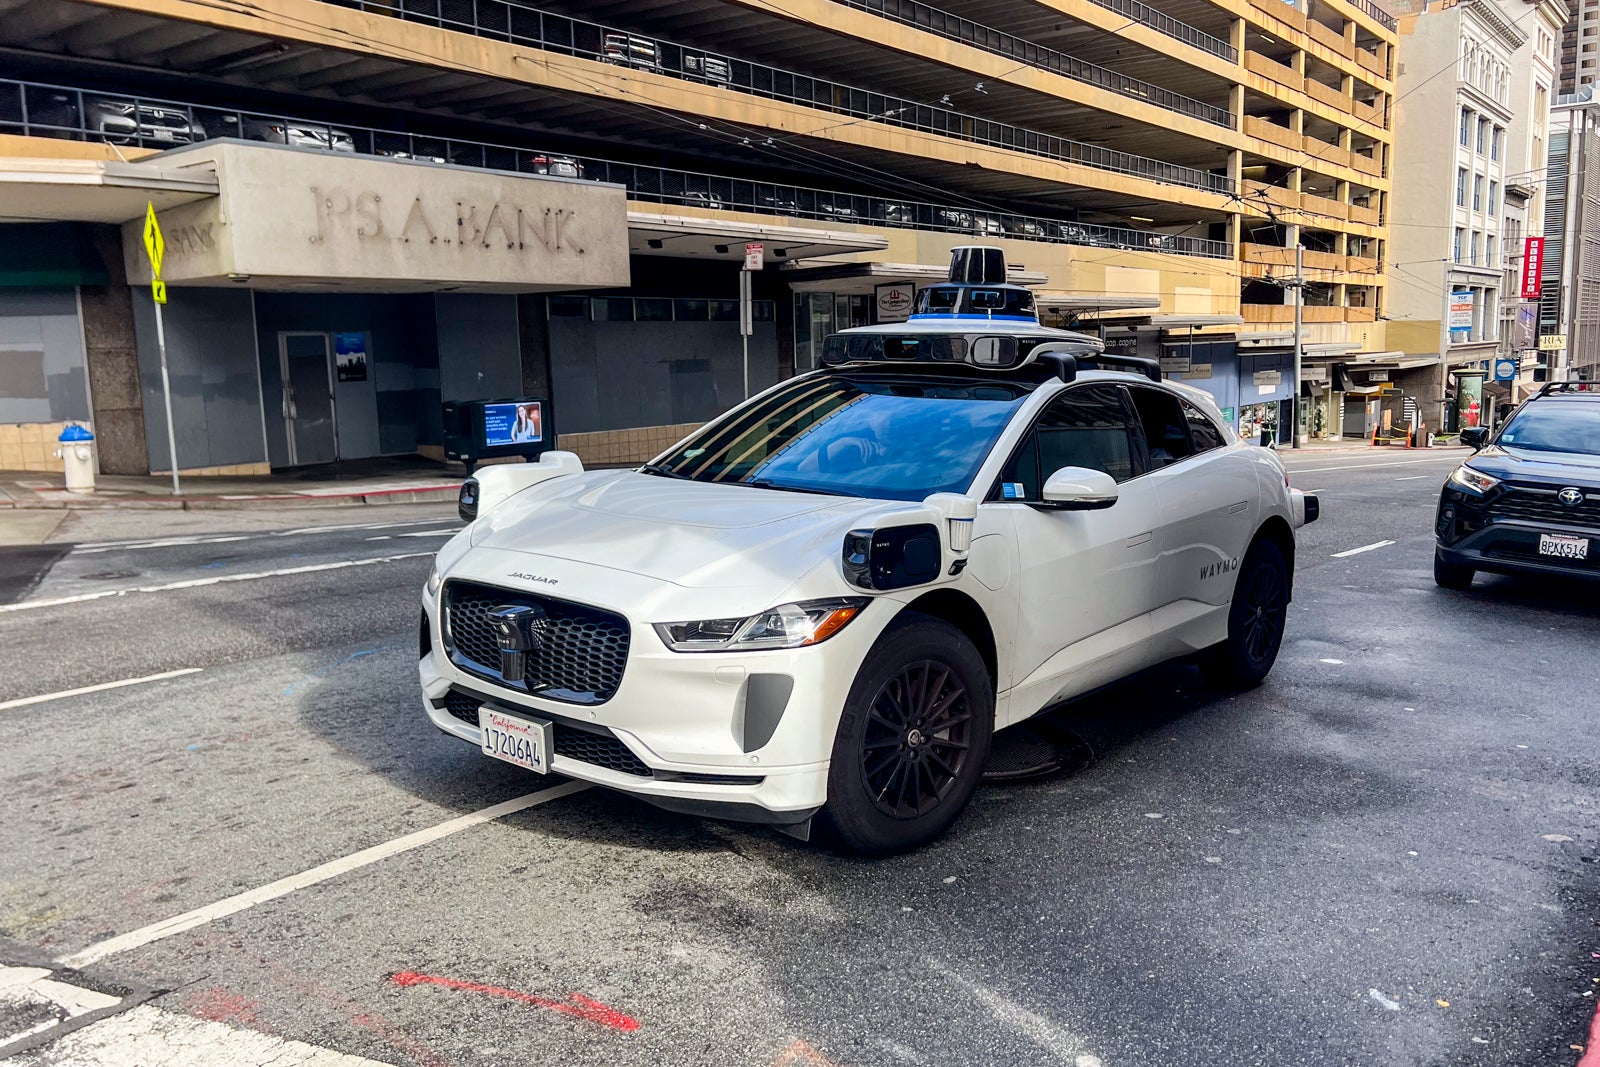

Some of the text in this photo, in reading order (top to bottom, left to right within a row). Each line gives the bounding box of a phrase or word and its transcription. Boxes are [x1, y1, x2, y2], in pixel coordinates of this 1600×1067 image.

[456, 199, 584, 254] BANK
[1541, 540, 1586, 556] 8PKK516
[506, 571, 559, 585] JAGUAR
[1200, 556, 1238, 580] WAYMO
[492, 714, 532, 736] California
[485, 727, 541, 766] 17206A4
